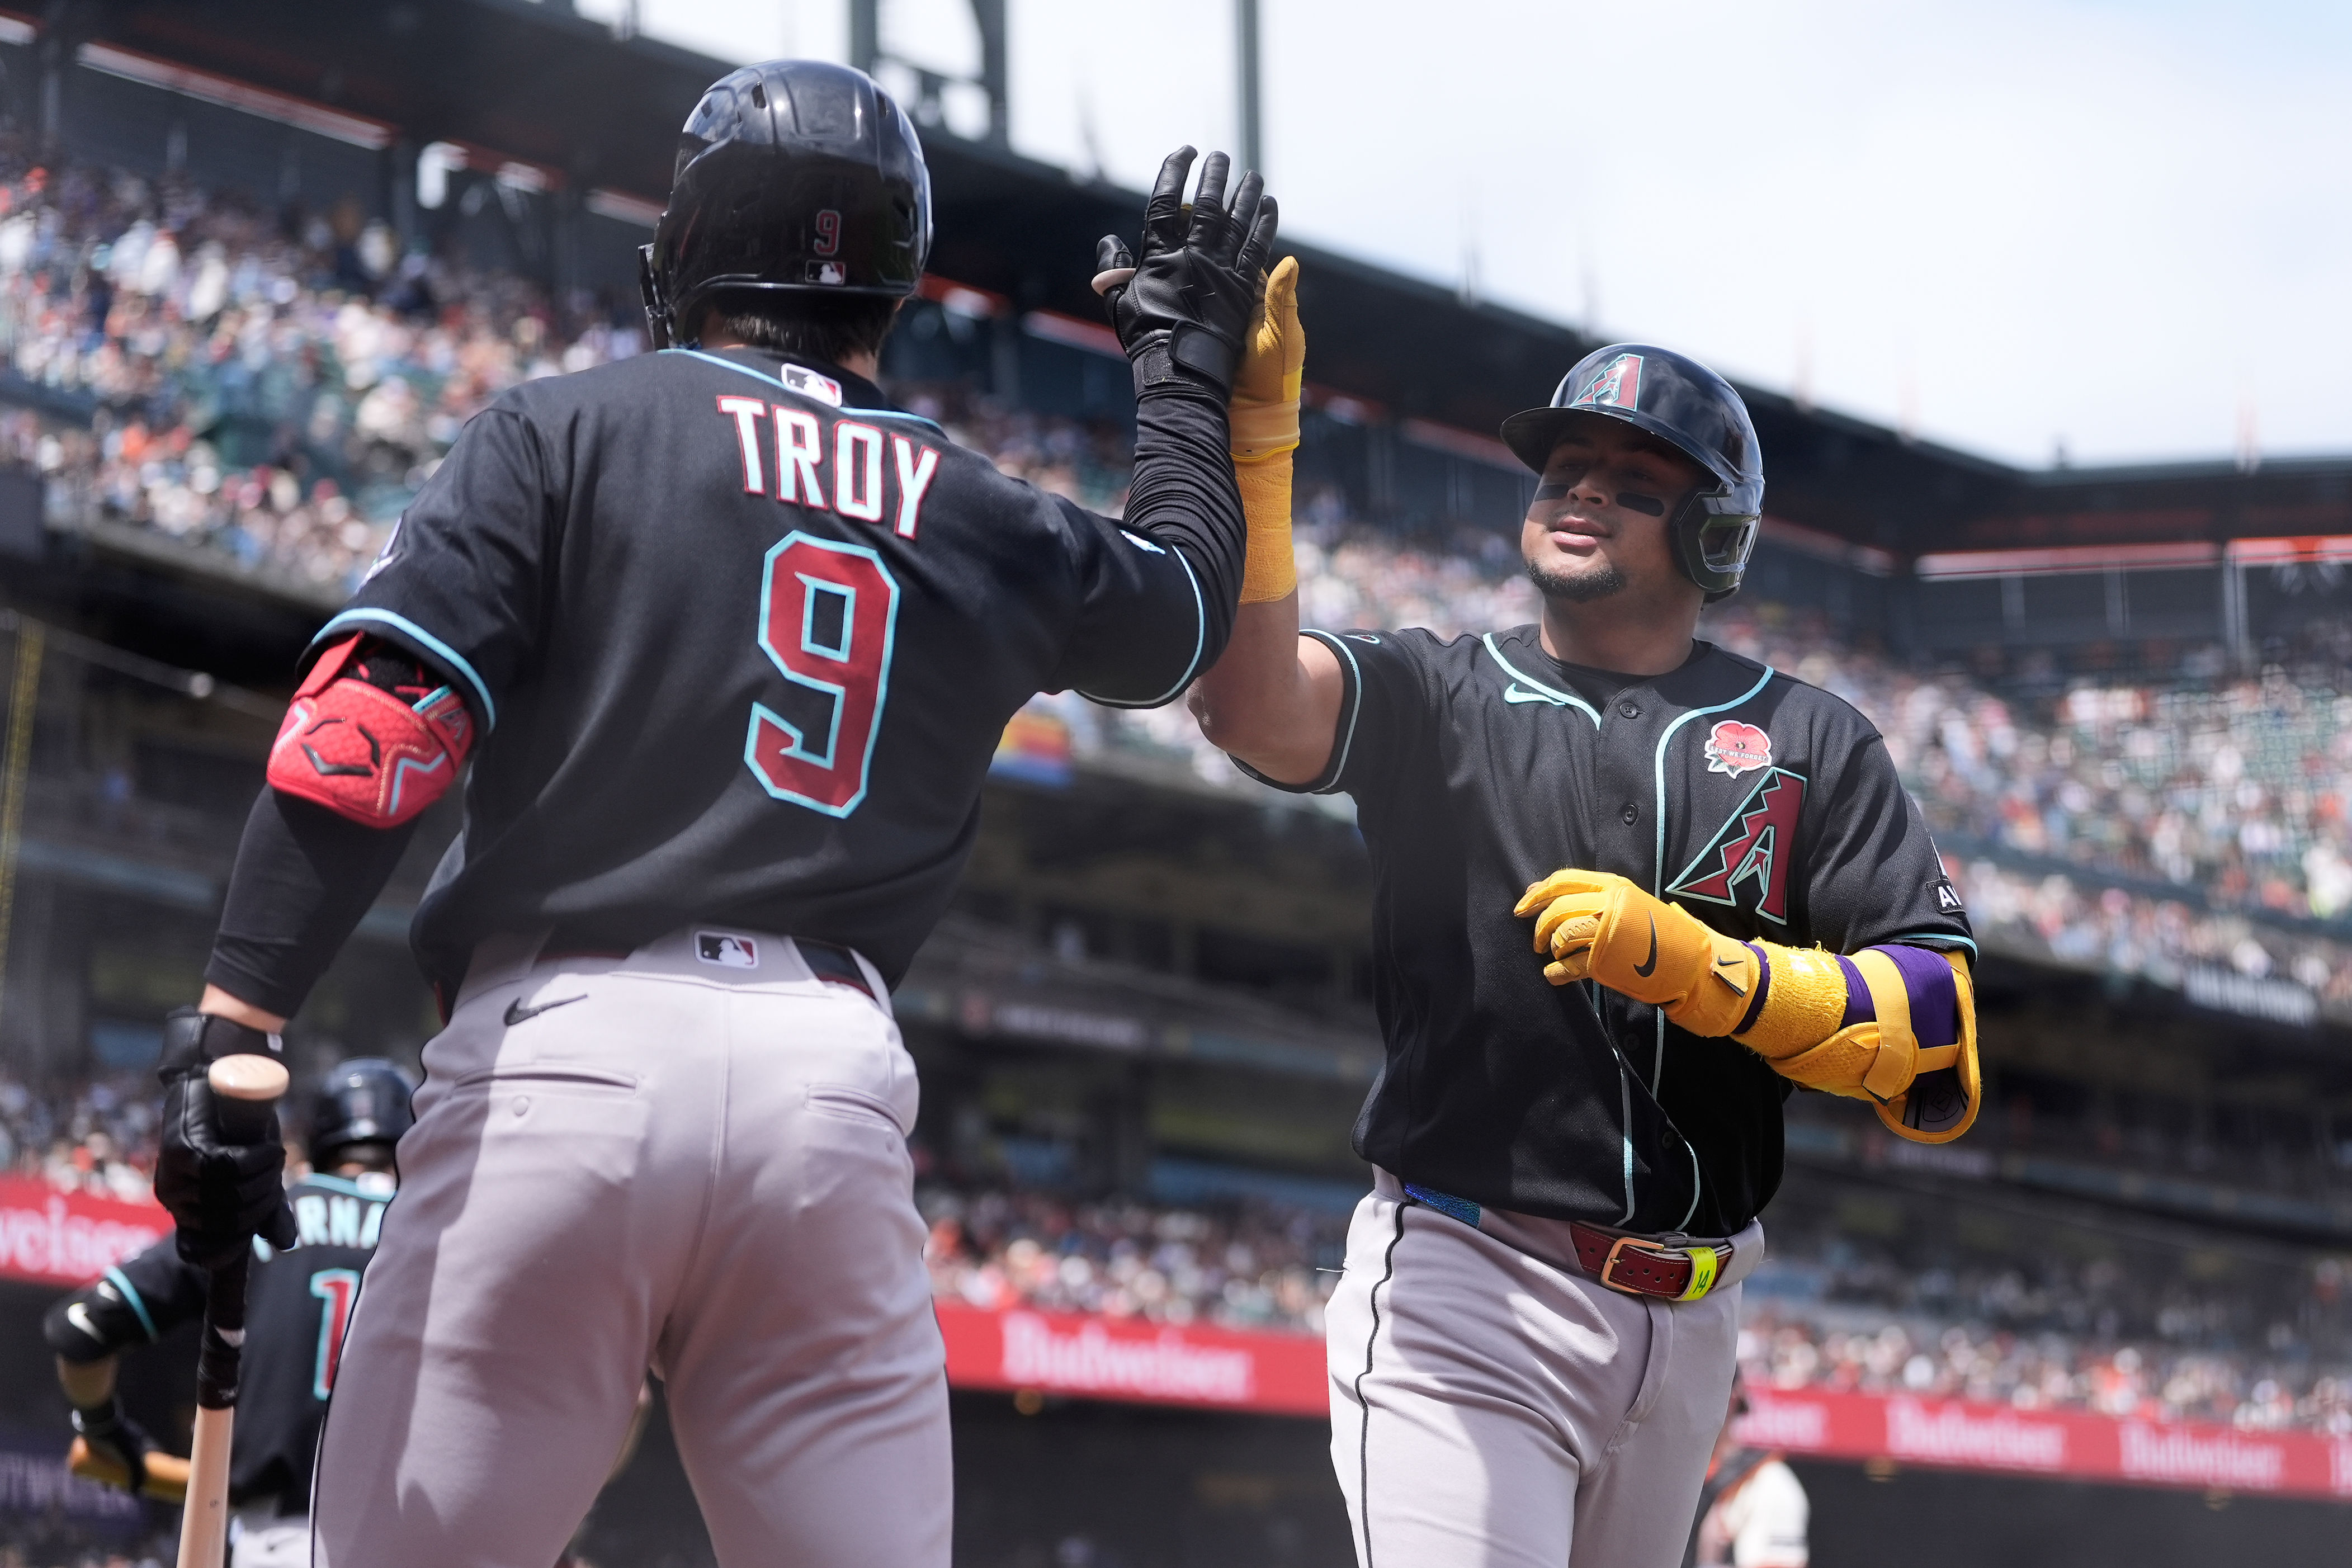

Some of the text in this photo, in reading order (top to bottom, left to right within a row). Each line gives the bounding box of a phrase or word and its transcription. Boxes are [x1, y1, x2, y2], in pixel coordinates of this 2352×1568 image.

[814, 209, 841, 255] 9
[716, 394, 941, 540] TROY
[744, 530, 900, 819] 9
[1710, 745, 1727, 755] LEST
[1740, 753, 1767, 762] FORGET
[1692, 1270, 1710, 1294] 14
